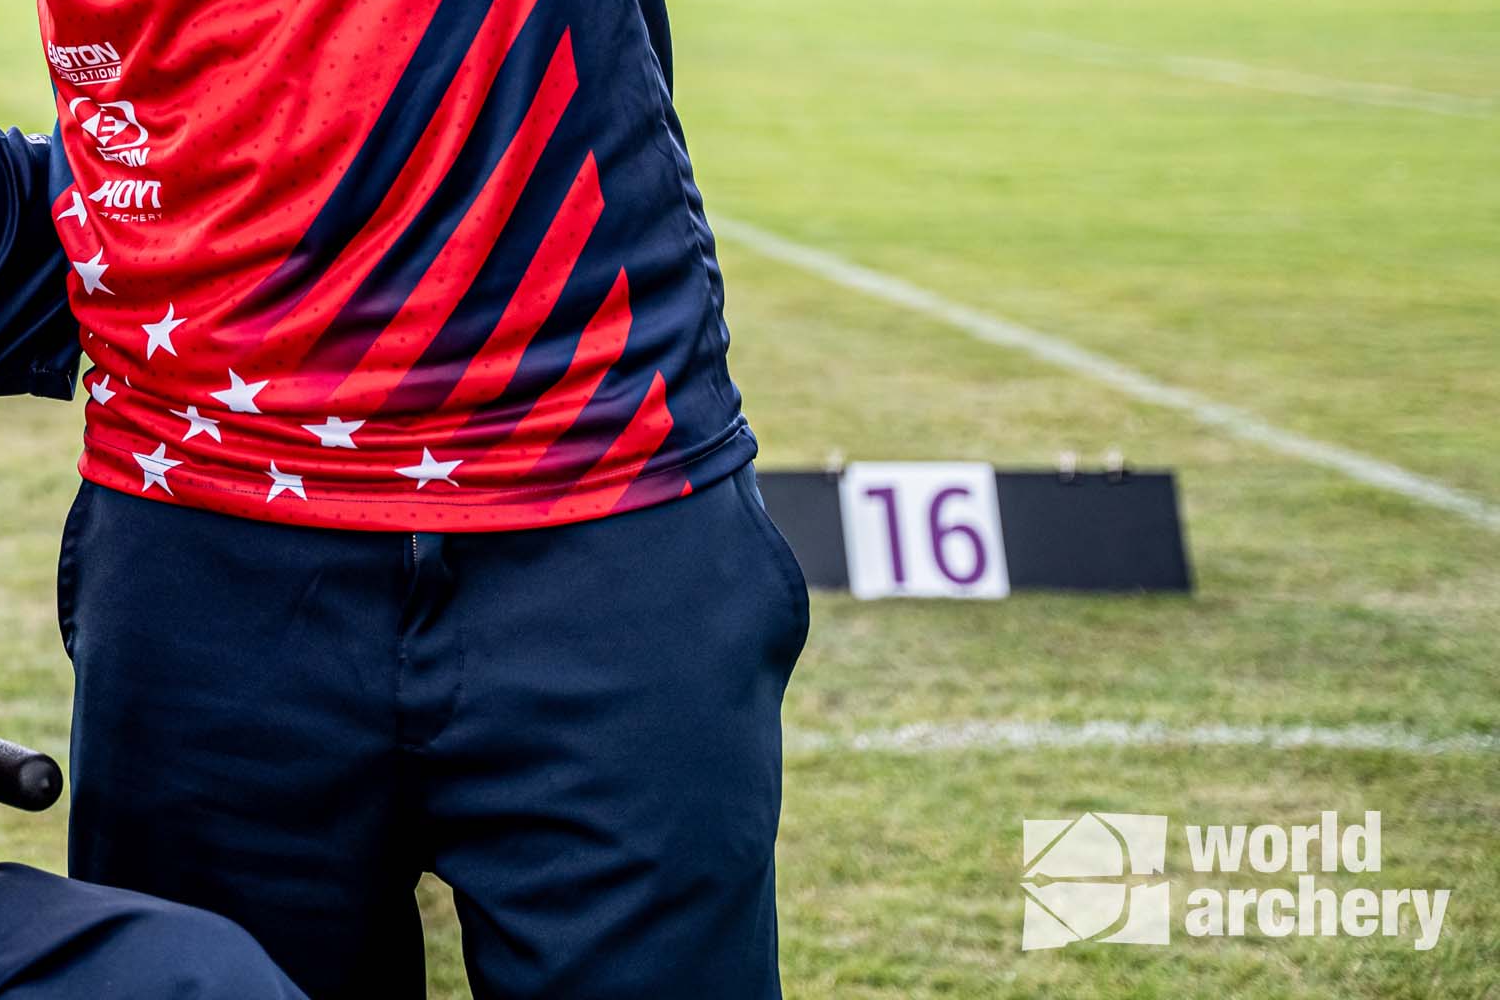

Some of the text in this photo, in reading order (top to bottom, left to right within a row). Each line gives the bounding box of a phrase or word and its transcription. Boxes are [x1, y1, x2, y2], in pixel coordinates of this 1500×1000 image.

[47, 40, 121, 68] EASTON
[55, 65, 122, 83] DATIONS
[88, 180, 162, 209] HOYT
[863, 486, 988, 586] 16
